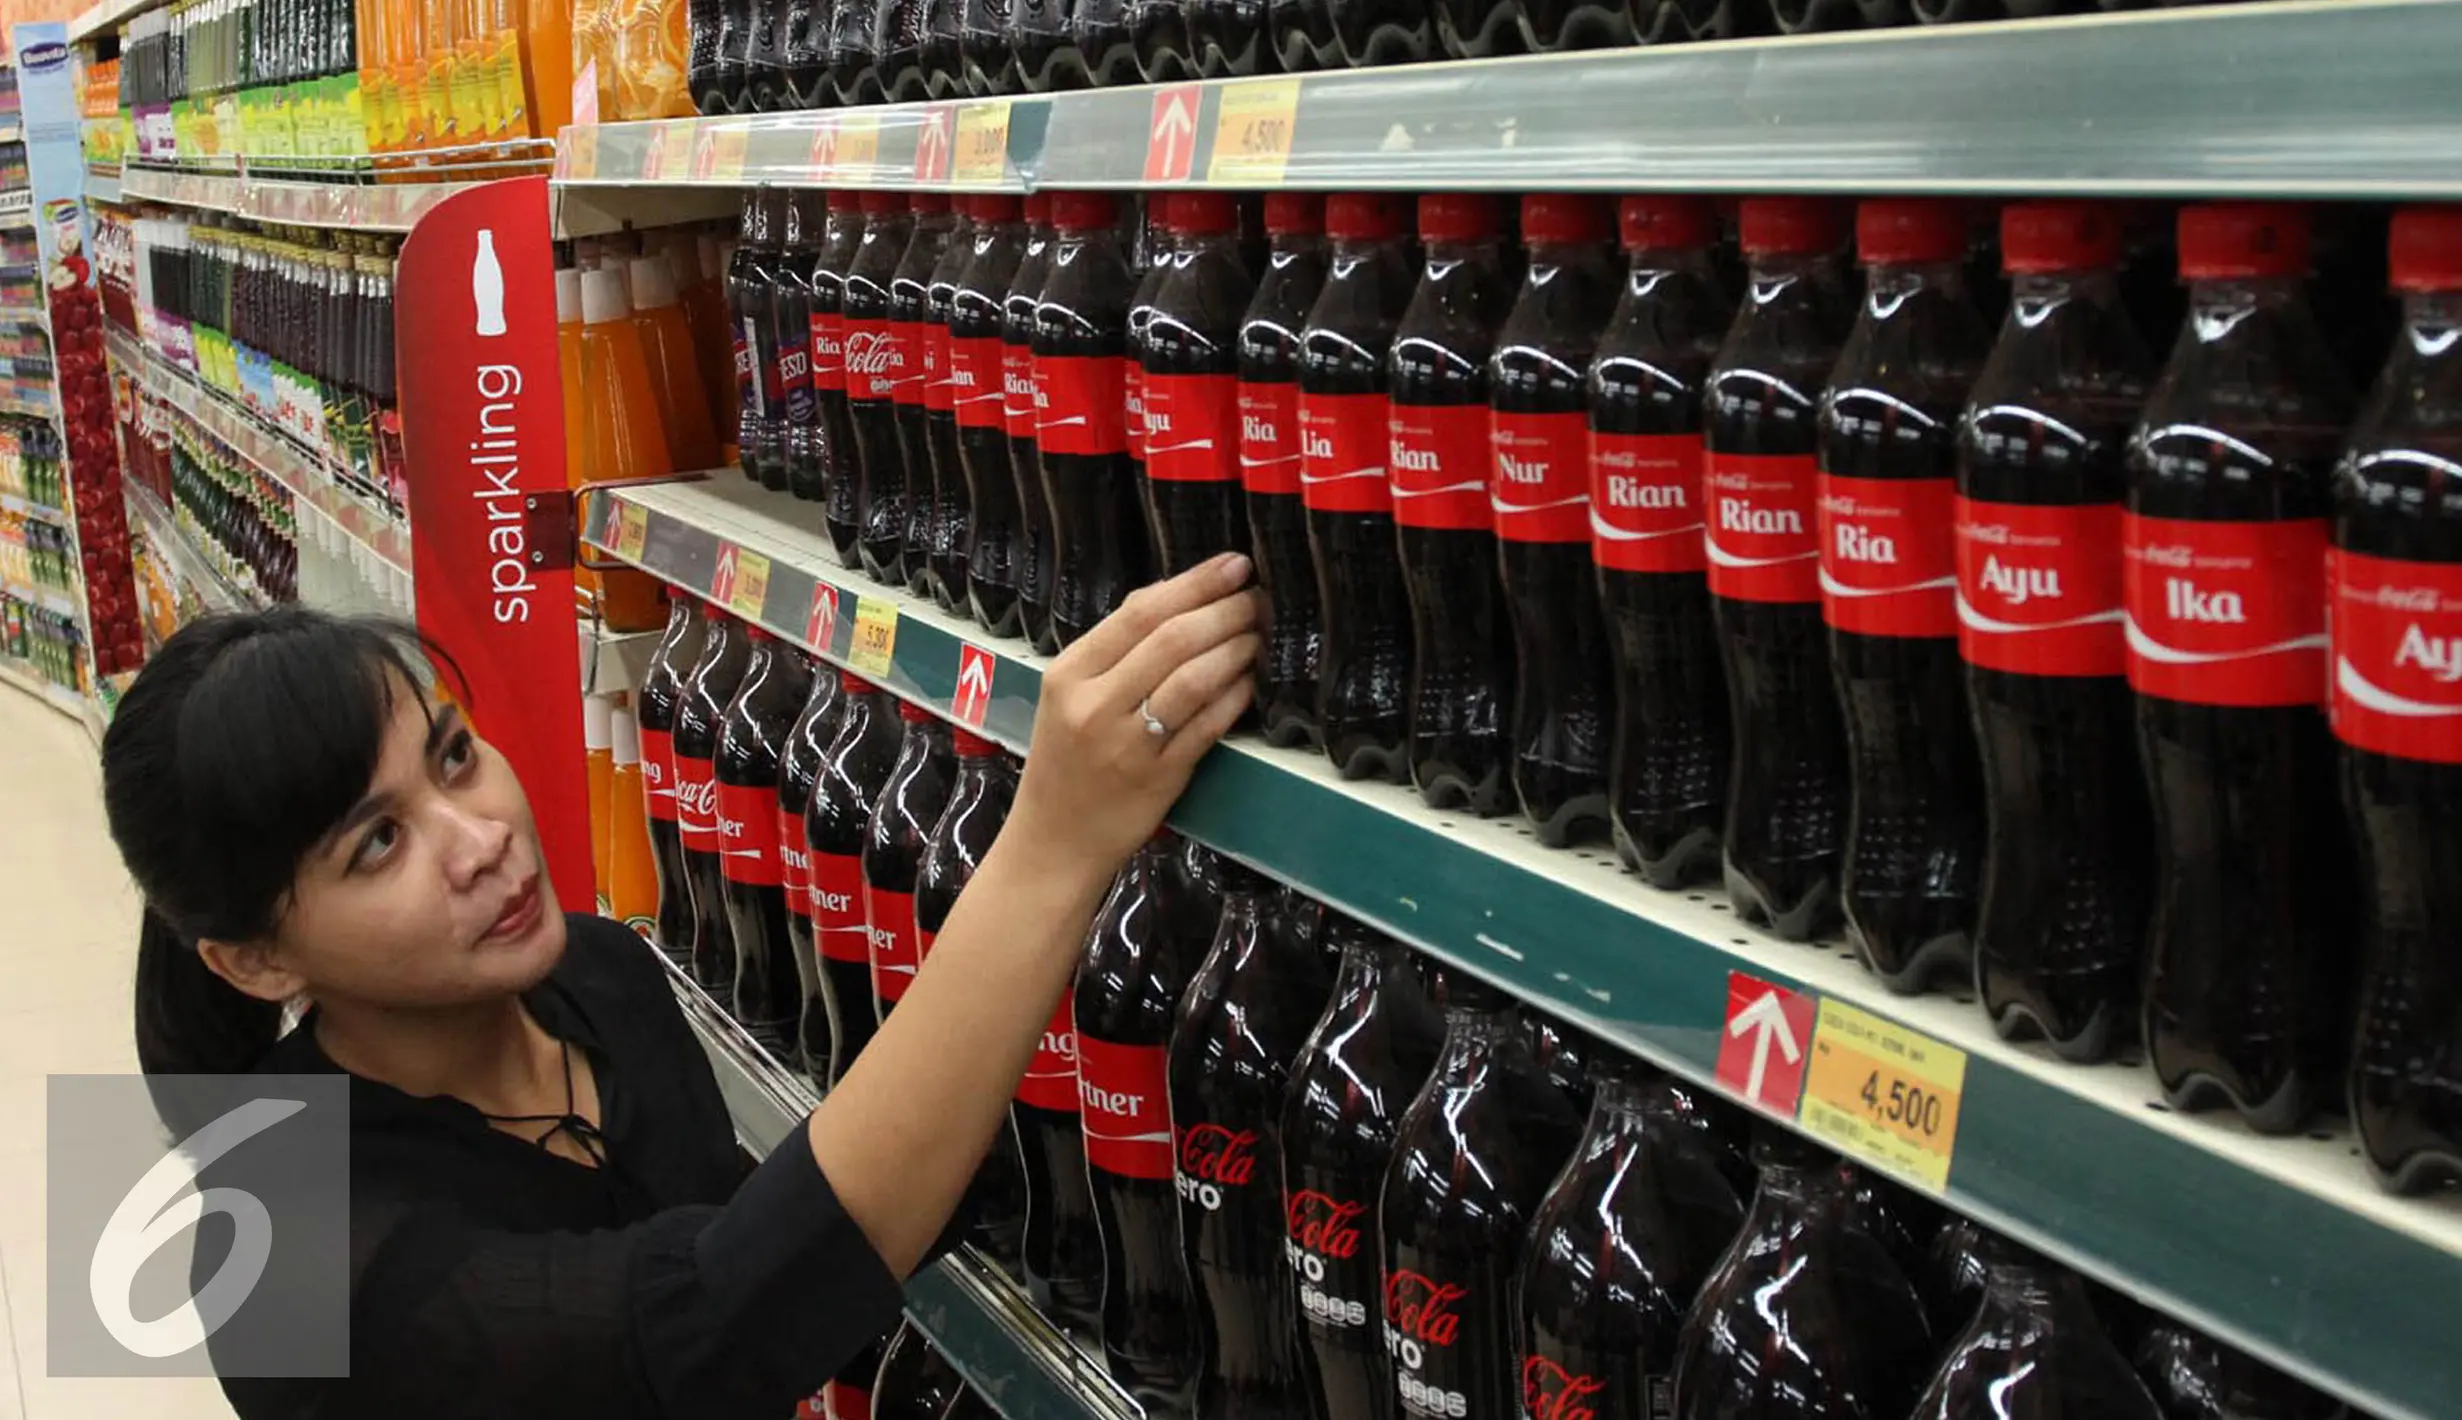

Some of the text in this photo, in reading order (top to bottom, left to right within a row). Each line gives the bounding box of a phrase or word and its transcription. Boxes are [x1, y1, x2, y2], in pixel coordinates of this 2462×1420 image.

[1242, 415, 1277, 442] Ria
[470, 364, 537, 623] sparkling
[1498, 454, 1550, 484] Nur
[1607, 474, 1687, 508] Rian
[1719, 496, 1803, 534] Rian
[1835, 522, 1897, 564] Ria
[1979, 552, 2063, 605] Ayu
[2165, 575, 2248, 624] Ika
[1861, 1070, 1942, 1137] 4,500
[1288, 1188, 1368, 1259] Cola
[1386, 1268, 1469, 1347] Cola
